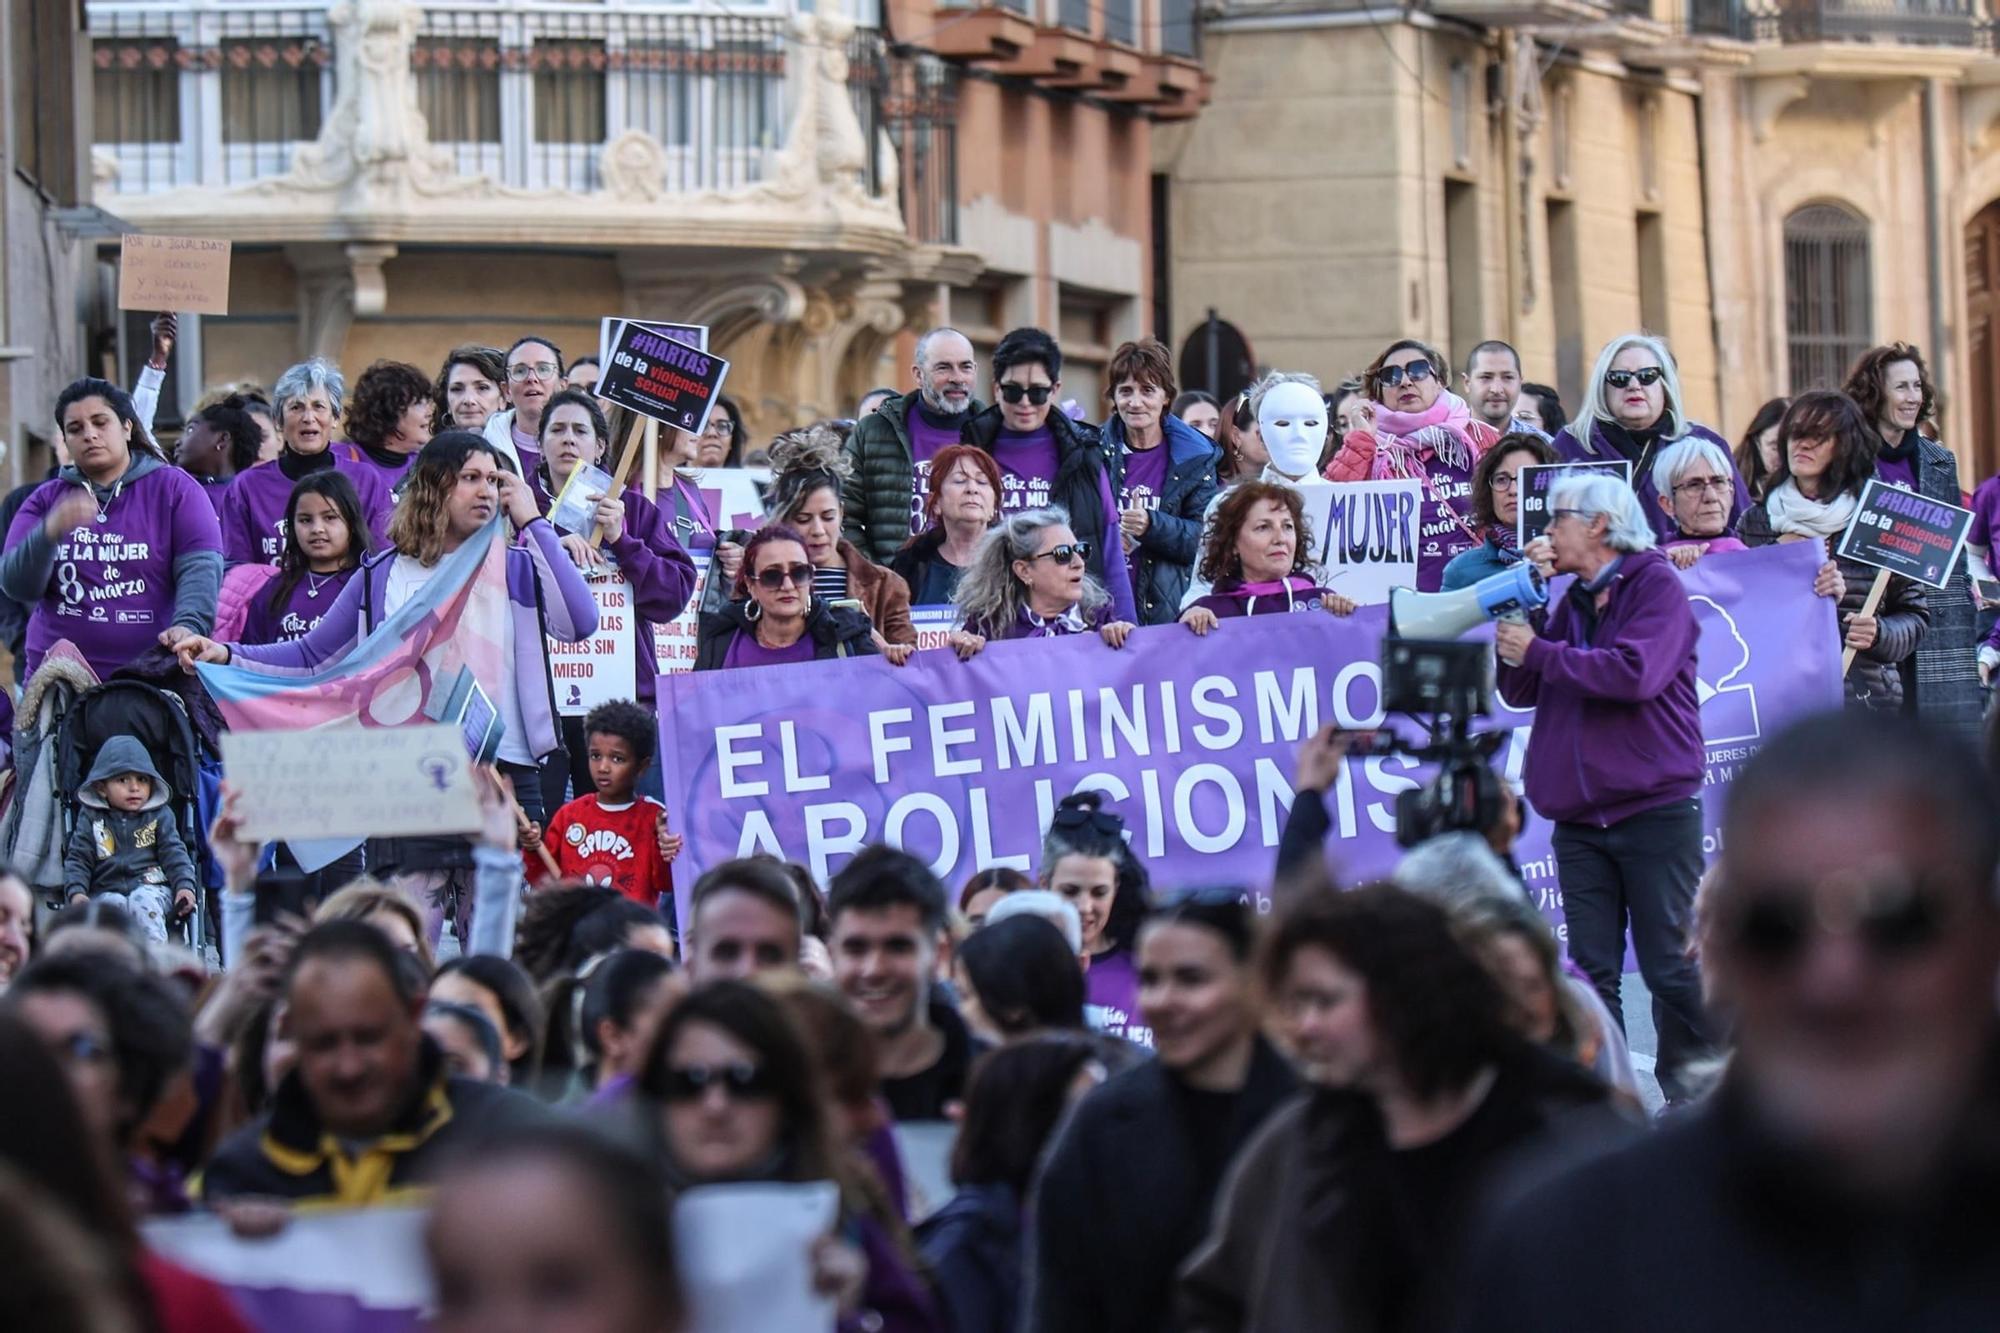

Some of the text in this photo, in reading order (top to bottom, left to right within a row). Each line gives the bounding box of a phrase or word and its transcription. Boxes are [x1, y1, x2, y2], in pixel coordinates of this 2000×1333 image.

[629, 332, 711, 377] #HARTAS
[614, 351, 633, 368] de
[633, 357, 649, 376] la
[650, 366, 710, 400] violencia
[634, 375, 679, 402] sexual
[1525, 496, 1543, 512] de
[1875, 490, 1956, 530] #HARTAS
[70, 526, 99, 544] Feliz
[1321, 491, 1414, 565] MUJER
[1859, 510, 1953, 551] de la violencia
[73, 543, 94, 561] LA
[98, 543, 149, 562] MUJER
[262, 537, 278, 555] DE
[1878, 532, 1923, 556] sexual
[58, 562, 121, 605] 8 de
[88, 579, 146, 602] marzo
[602, 592, 625, 608] LOS
[600, 615, 623, 632] LAS
[594, 639, 615, 655] SIN
[656, 644, 699, 660] EGAL PAR
[553, 662, 594, 679] MIEDO
[715, 660, 1391, 799] EL FEMINISMO
[577, 829, 635, 861] SPIDEY
